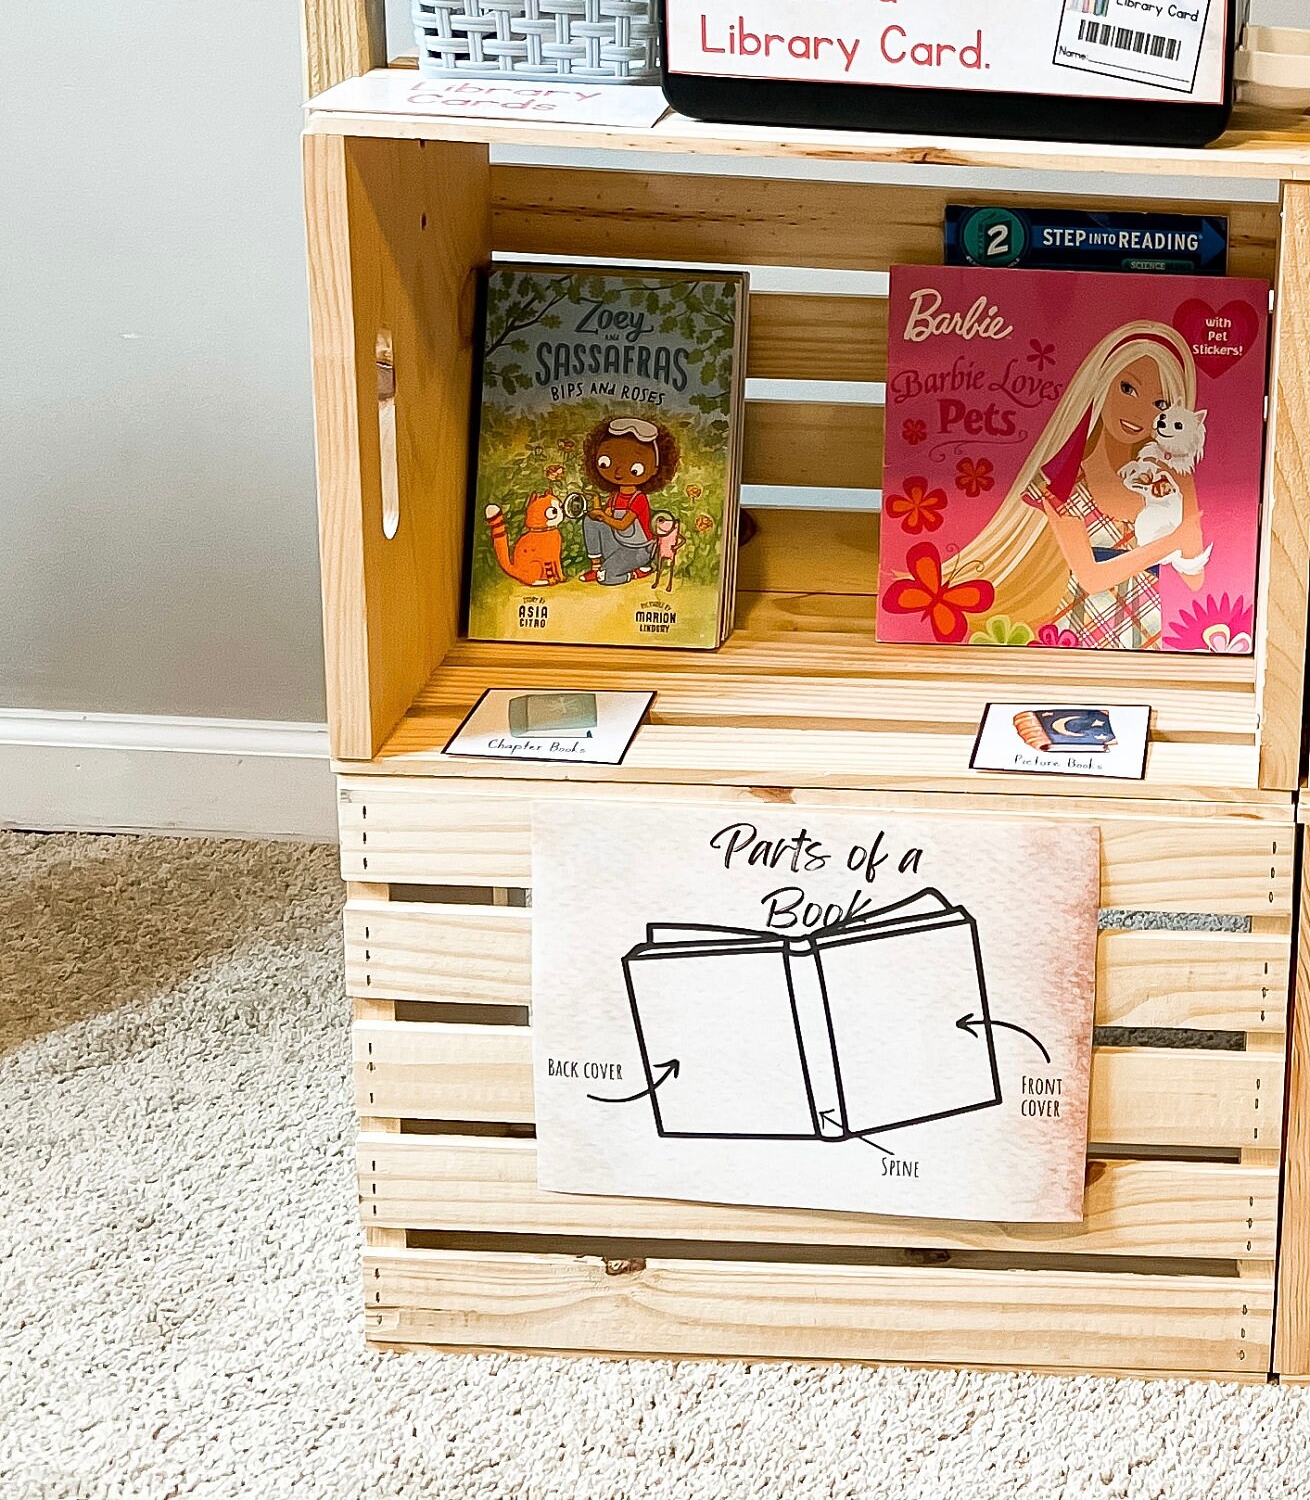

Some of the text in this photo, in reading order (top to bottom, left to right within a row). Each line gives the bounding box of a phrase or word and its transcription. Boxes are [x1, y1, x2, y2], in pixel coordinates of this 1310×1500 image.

[1168, 4, 1200, 22] Card
[699, 15, 991, 72] Library Card.
[407, 93, 557, 111] Cards
[410, 81, 602, 102] Library
[986, 224, 1010, 257] 2
[1042, 228, 1199, 251] STEP INTO READING
[1130, 260, 1167, 271] SCIENCE
[574, 296, 654, 343] Zoey
[902, 287, 1014, 343] Barbie
[1204, 316, 1232, 330] with
[1207, 330, 1228, 343] Pet
[1191, 343, 1244, 357] Stickers!
[534, 341, 691, 393] SASSAFRAS
[890, 355, 1063, 409] Barbie Loves
[550, 382, 584, 401] BIPS
[621, 384, 666, 407] ROSES
[937, 398, 1018, 438] Pets
[518, 605, 548, 619] ASIA
[519, 618, 546, 628] CITRO
[635, 611, 677, 624] MARION
[487, 738, 543, 755] Chapter
[1014, 754, 1060, 767] Picture
[709, 821, 925, 884] Parts of a
[760, 885, 873, 929] Book
[547, 1058, 624, 1082] BACK COVER
[1020, 1074, 1063, 1097] FRONT
[1020, 1097, 1062, 1120] COVER
[881, 1156, 921, 1179] SPINE
